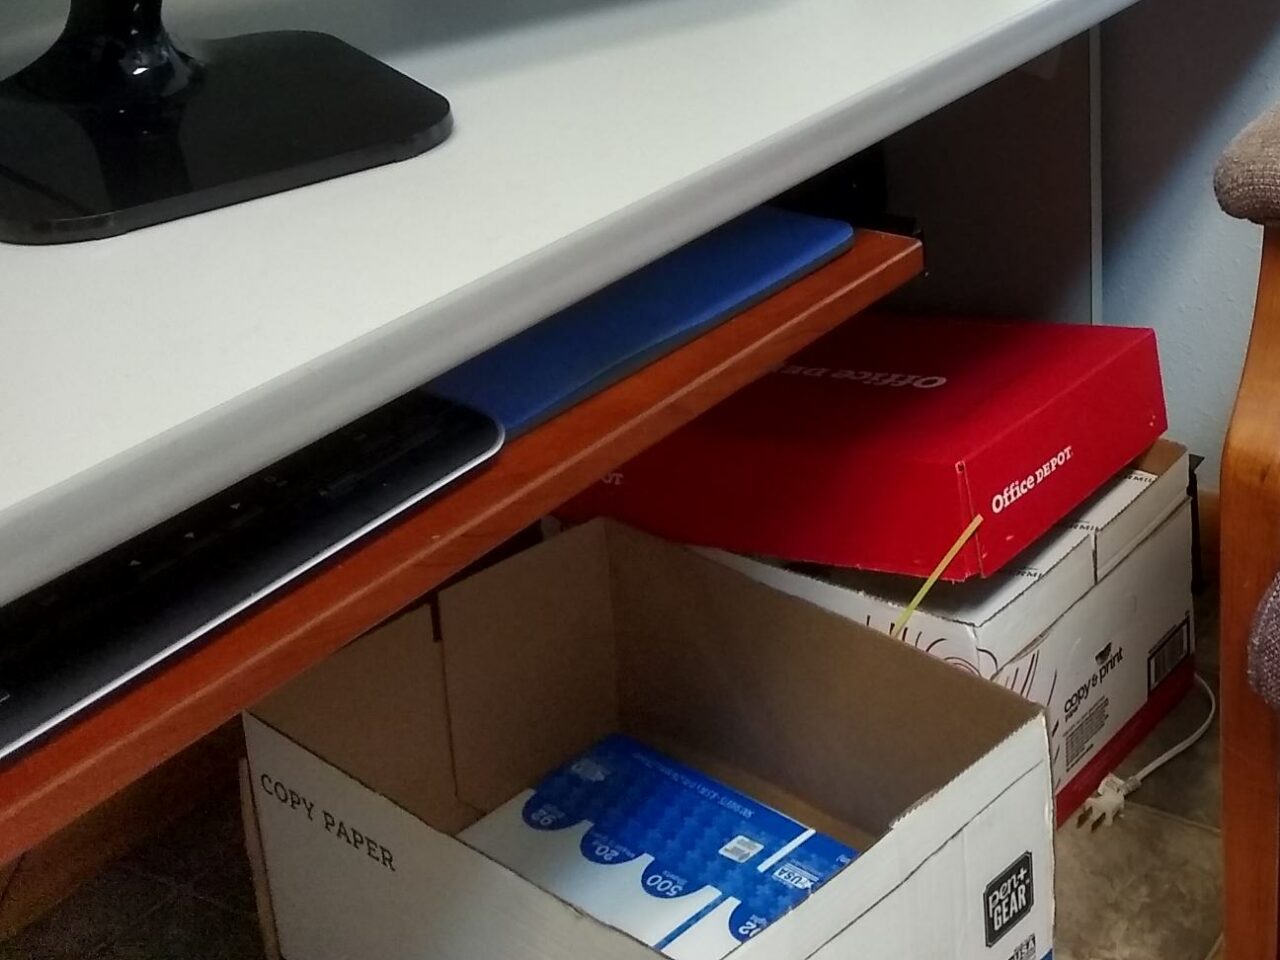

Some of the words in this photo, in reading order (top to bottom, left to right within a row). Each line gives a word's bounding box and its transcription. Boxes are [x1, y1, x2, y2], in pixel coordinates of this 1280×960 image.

[831, 369, 948, 389] Office
[992, 475, 1035, 513] Office
[1035, 445, 1073, 484] DEPOT
[1064, 679, 1093, 714] copy
[1098, 647, 1124, 684] print
[260, 773, 315, 821] COPY
[323, 810, 396, 872] PAPER
[646, 874, 683, 897] 500
[778, 868, 803, 885] USA
[989, 867, 1028, 918] pen+
[993, 884, 1027, 931] GEAR
